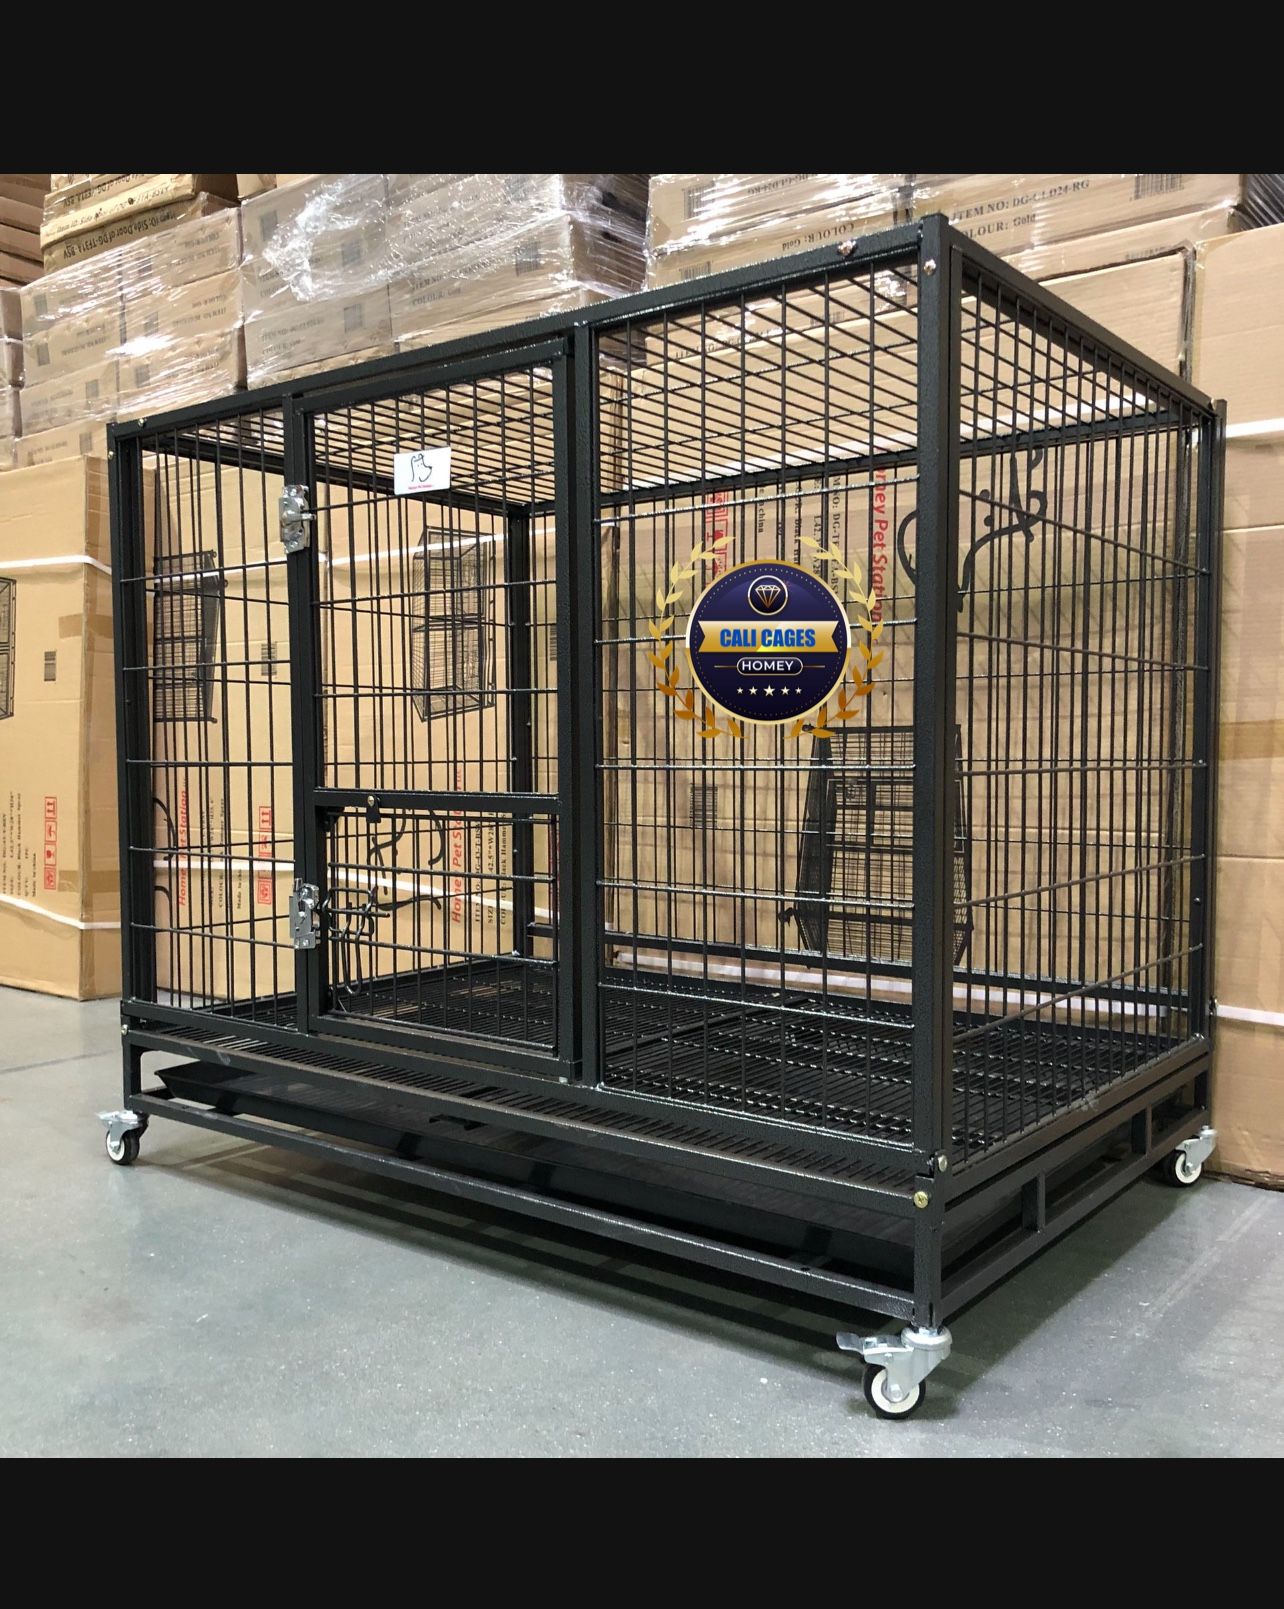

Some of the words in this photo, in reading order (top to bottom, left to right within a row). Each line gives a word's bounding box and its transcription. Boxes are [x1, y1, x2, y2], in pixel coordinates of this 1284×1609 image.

[988, 200, 1009, 213] NO:
[115, 223, 134, 237] Door
[804, 223, 855, 243] COLOUR:
[962, 220, 1009, 239] OLOUR:
[1013, 213, 1036, 227] Gold
[781, 239, 801, 251] Gold
[873, 520, 888, 550] Pet
[452, 843, 462, 867] Pet
